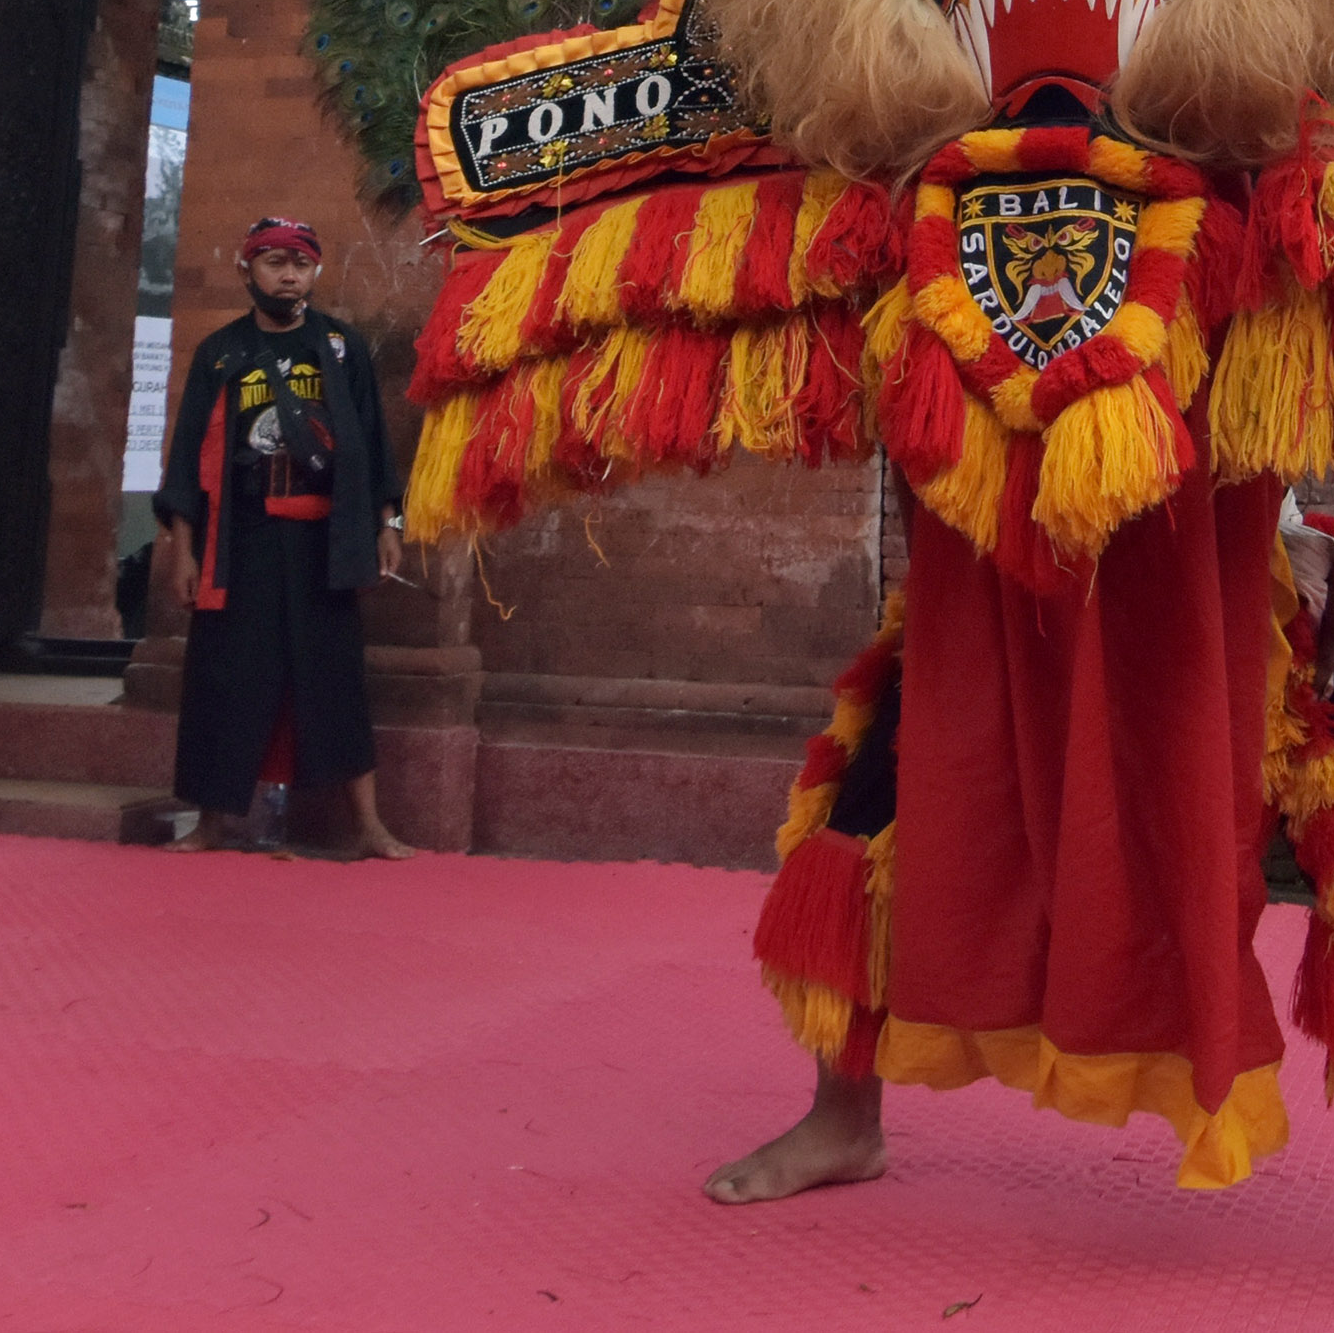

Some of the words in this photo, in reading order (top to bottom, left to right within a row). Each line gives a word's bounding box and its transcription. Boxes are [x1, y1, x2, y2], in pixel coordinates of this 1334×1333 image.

[476, 74, 673, 157] PONO
[998, 185, 1103, 216] BALI
[961, 231, 1048, 371] SARDULO
